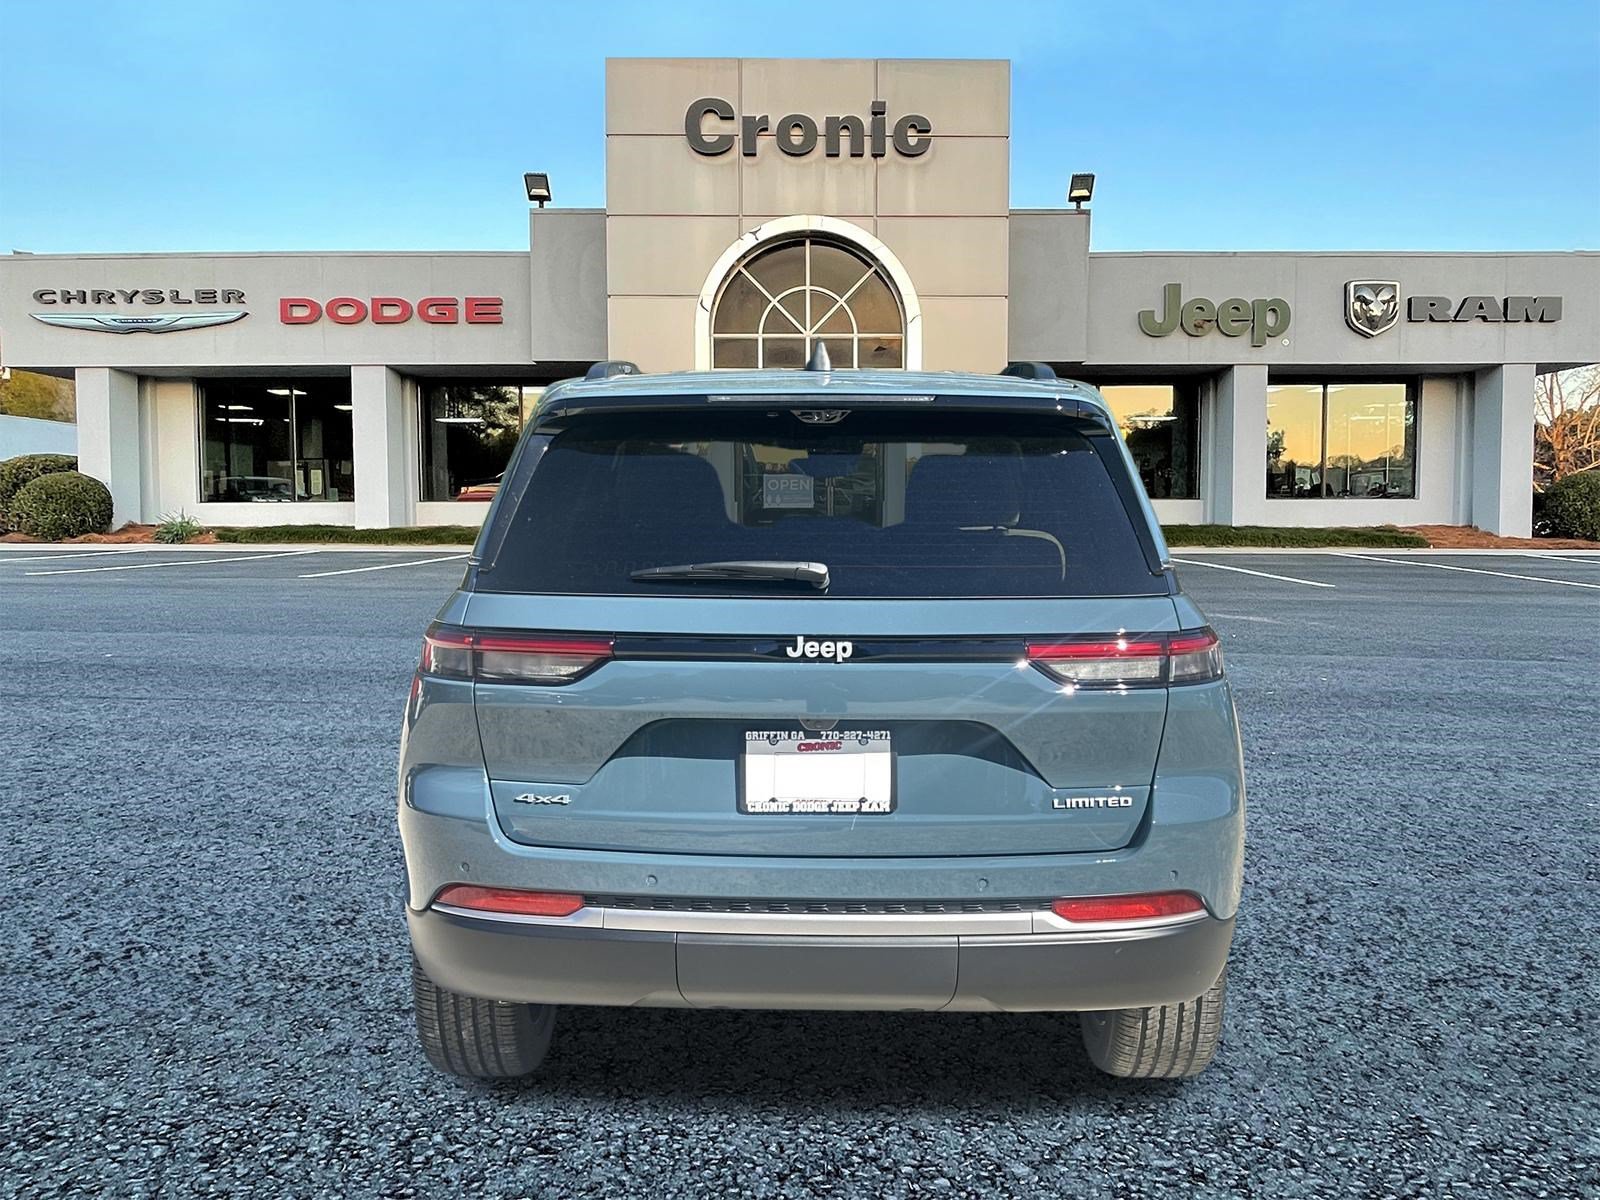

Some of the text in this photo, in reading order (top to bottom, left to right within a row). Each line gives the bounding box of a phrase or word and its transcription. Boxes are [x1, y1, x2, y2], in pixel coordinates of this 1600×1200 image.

[685, 97, 932, 157] Cronic
[32, 289, 247, 305] CHRYSLER
[280, 297, 504, 325] DODGE
[1138, 283, 1291, 347] Jeep
[1407, 296, 1562, 323] RAM
[767, 479, 810, 491] OPEN
[786, 636, 852, 662] Jeep
[745, 731, 805, 740] GRIFFIN GA
[820, 731, 891, 740] 770-227-4271
[797, 741, 842, 751] CRONIC
[513, 793, 571, 805] 4x4
[1052, 796, 1133, 809] LIMITED
[747, 801, 790, 812] CRONIC
[792, 801, 829, 812] DODGE
[831, 801, 860, 812] JEEP
